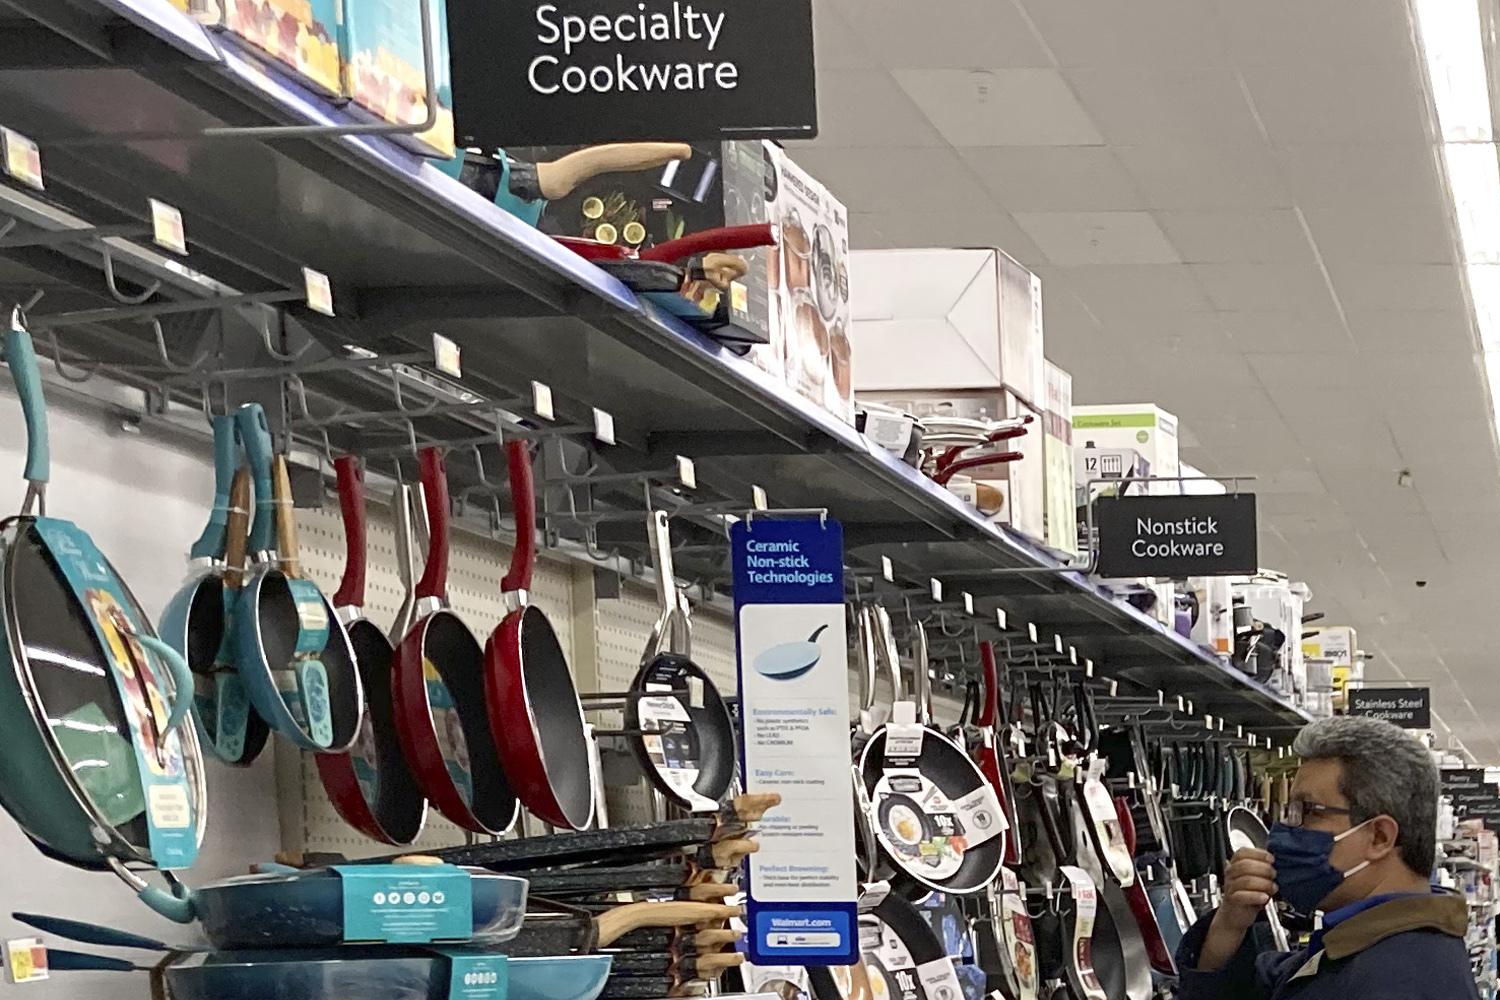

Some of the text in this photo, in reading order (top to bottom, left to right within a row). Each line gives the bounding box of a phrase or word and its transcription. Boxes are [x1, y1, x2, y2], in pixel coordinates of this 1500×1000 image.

[535, 2, 726, 53] Specialty
[527, 54, 740, 95] Cookware
[1136, 516, 1219, 537] Nonstick
[746, 539, 800, 553] Ceramic
[1131, 538, 1225, 558] Cookware
[747, 554, 810, 568] Non-stick
[747, 570, 834, 586] Technologies
[1355, 698, 1424, 710] Stainless Steel
[771, 918, 832, 927] Walmart.com
